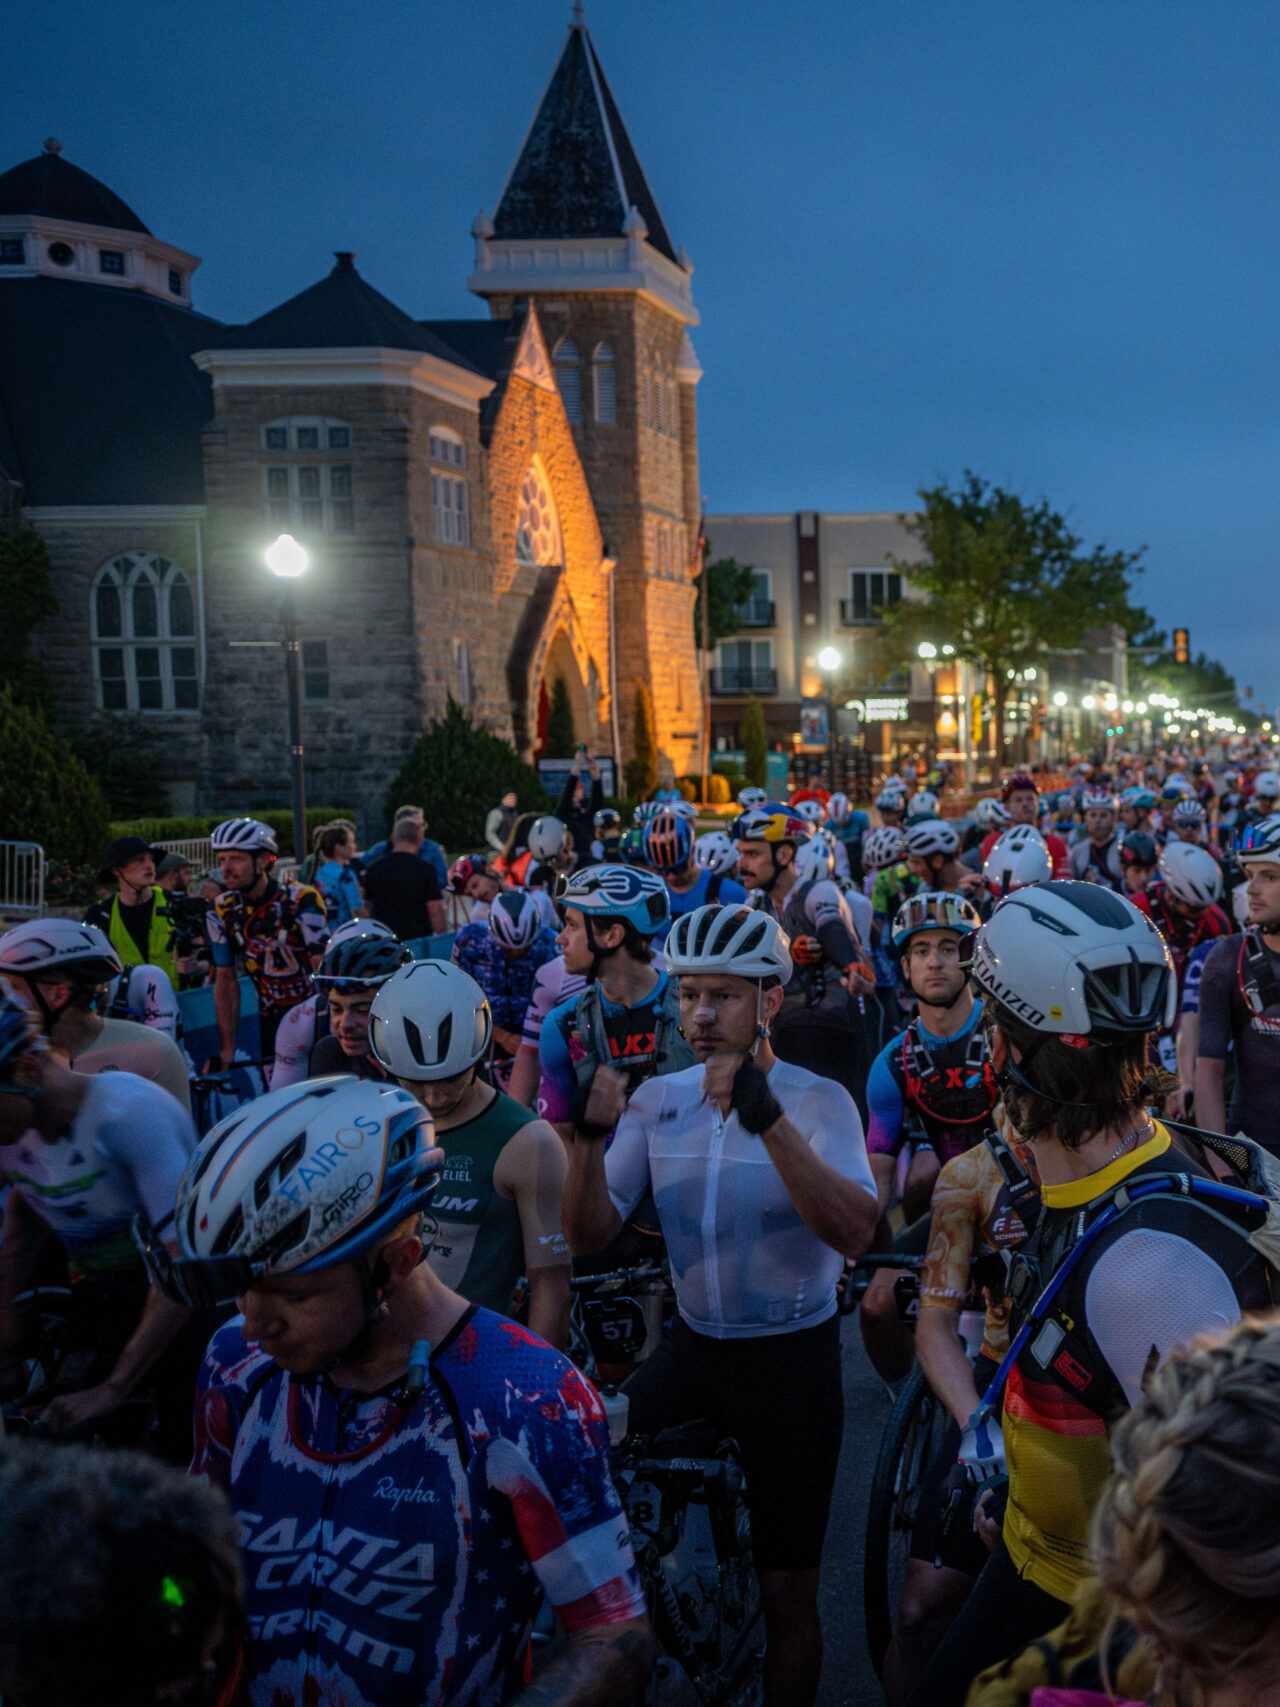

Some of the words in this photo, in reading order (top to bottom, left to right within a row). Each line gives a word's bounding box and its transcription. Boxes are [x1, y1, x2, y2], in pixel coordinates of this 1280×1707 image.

[280, 1116, 381, 1204] FAIROS
[443, 1169, 472, 1183] ELIEL
[318, 1171, 373, 1229] GIRO
[602, 1319, 634, 1341] 57
[233, 1510, 435, 1582] SANTA
[255, 1552, 437, 1622] CRUZ
[247, 1608, 416, 1675] SRAM
